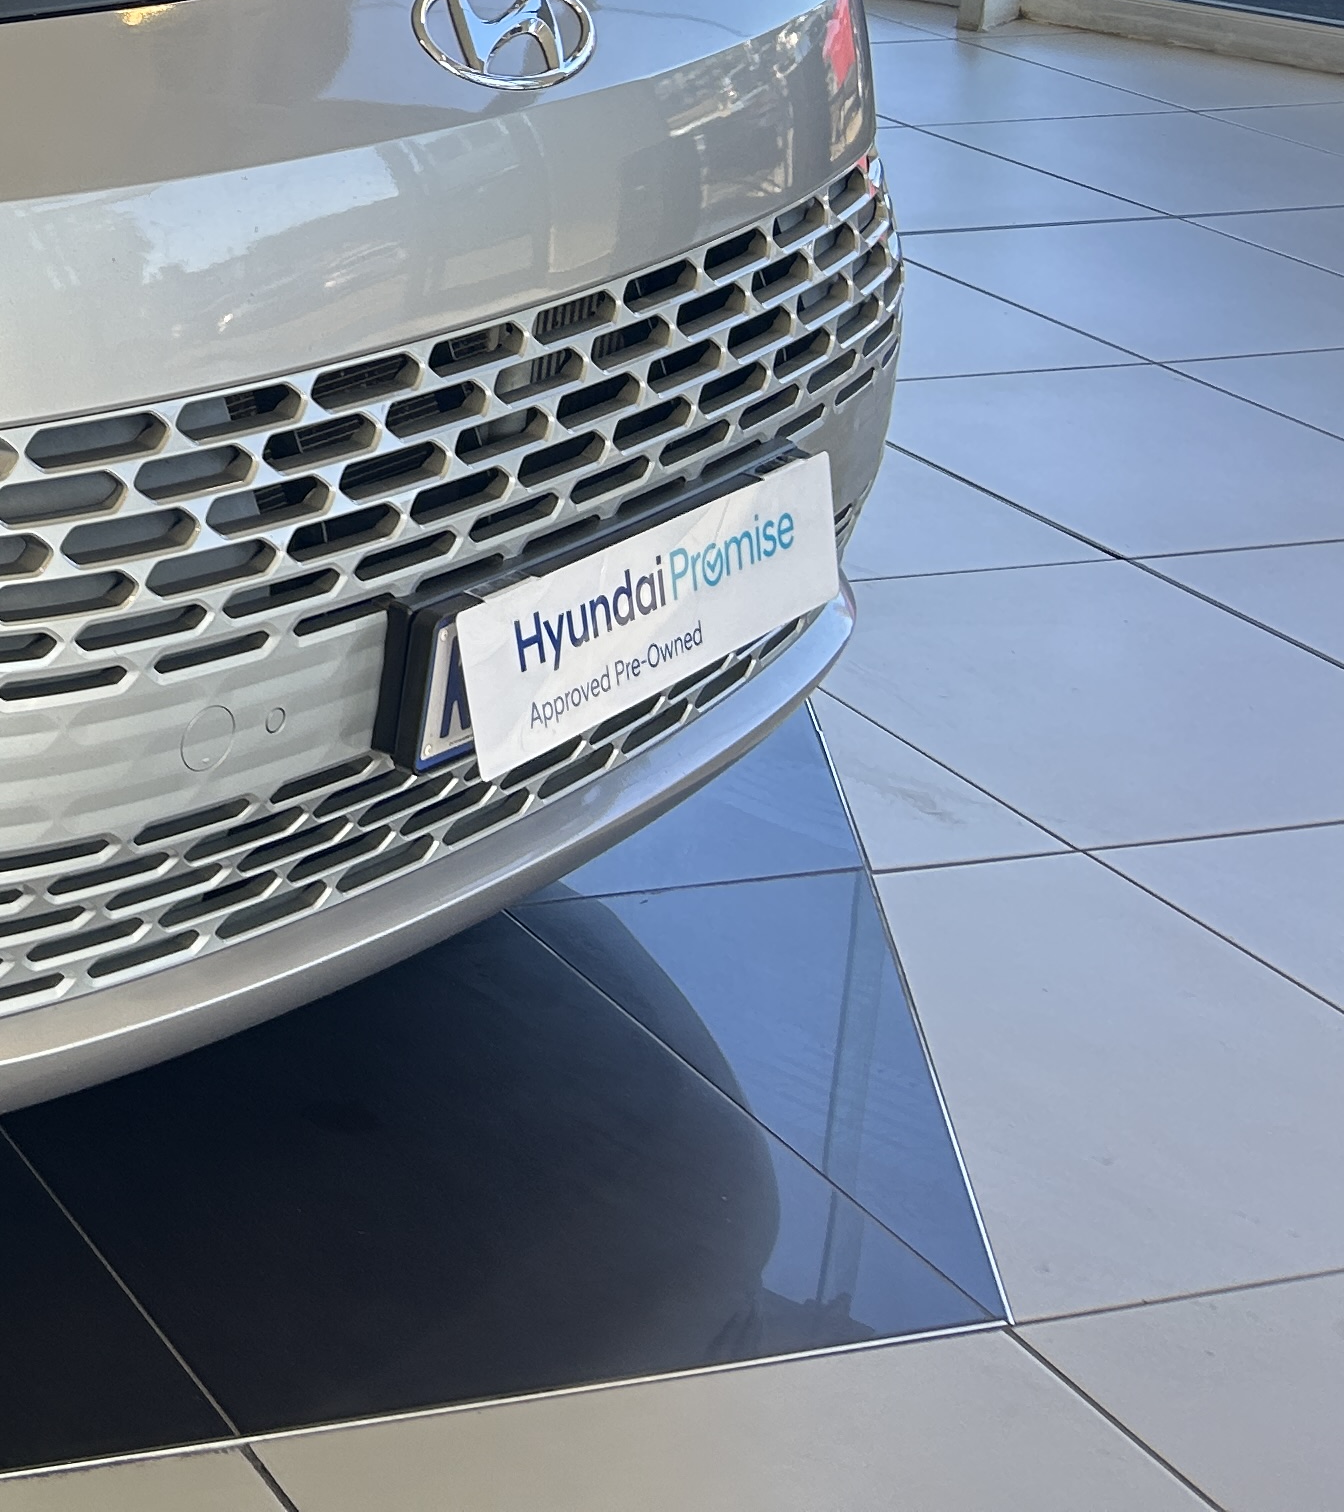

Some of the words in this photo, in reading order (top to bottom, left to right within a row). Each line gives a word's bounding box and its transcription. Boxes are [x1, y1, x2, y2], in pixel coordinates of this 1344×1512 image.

[513, 554, 667, 673] Hyundai
[669, 512, 795, 601] Promise
[529, 663, 611, 730] Approved
[614, 619, 704, 687] Pre-Owned
